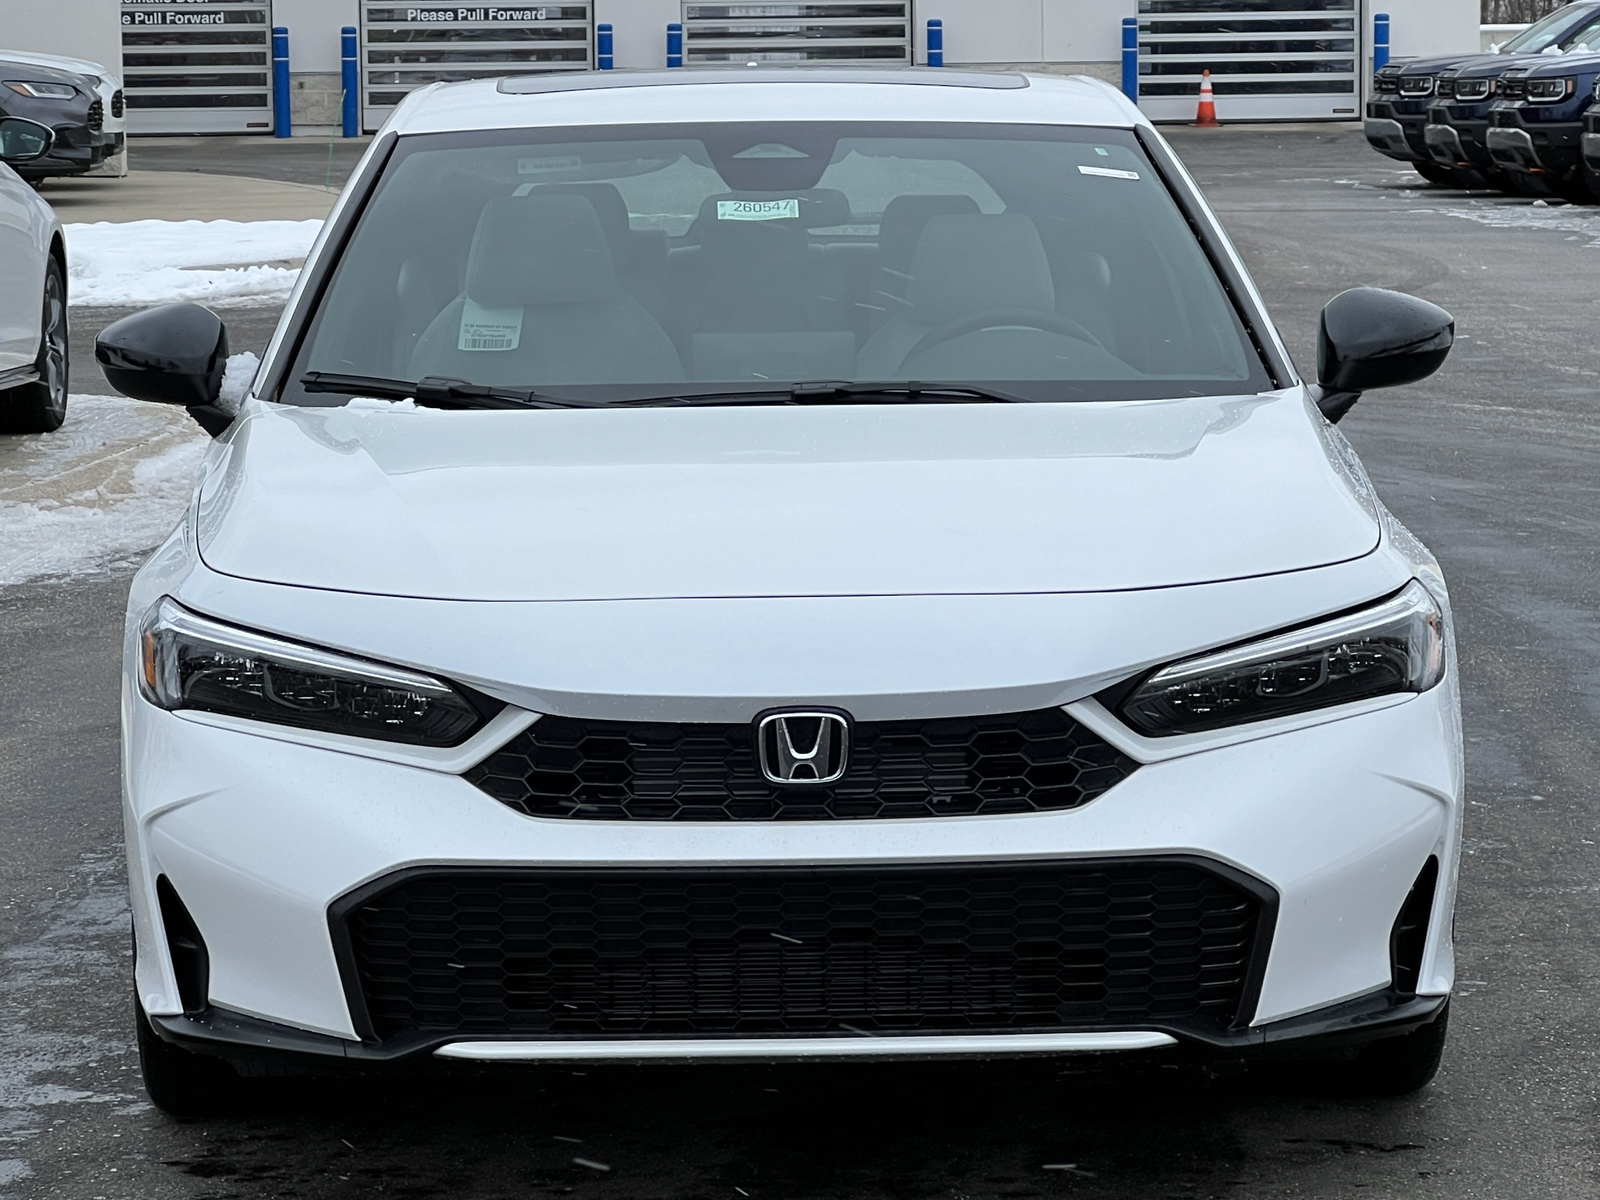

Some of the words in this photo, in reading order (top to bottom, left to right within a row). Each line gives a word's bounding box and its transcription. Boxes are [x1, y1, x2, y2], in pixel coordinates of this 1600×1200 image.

[134, 12, 162, 24] Pull
[166, 12, 225, 24] Forward
[407, 9, 454, 21] Please
[457, 8, 485, 21] Pull
[488, 8, 547, 20] Forward
[733, 200, 790, 213] 260547
